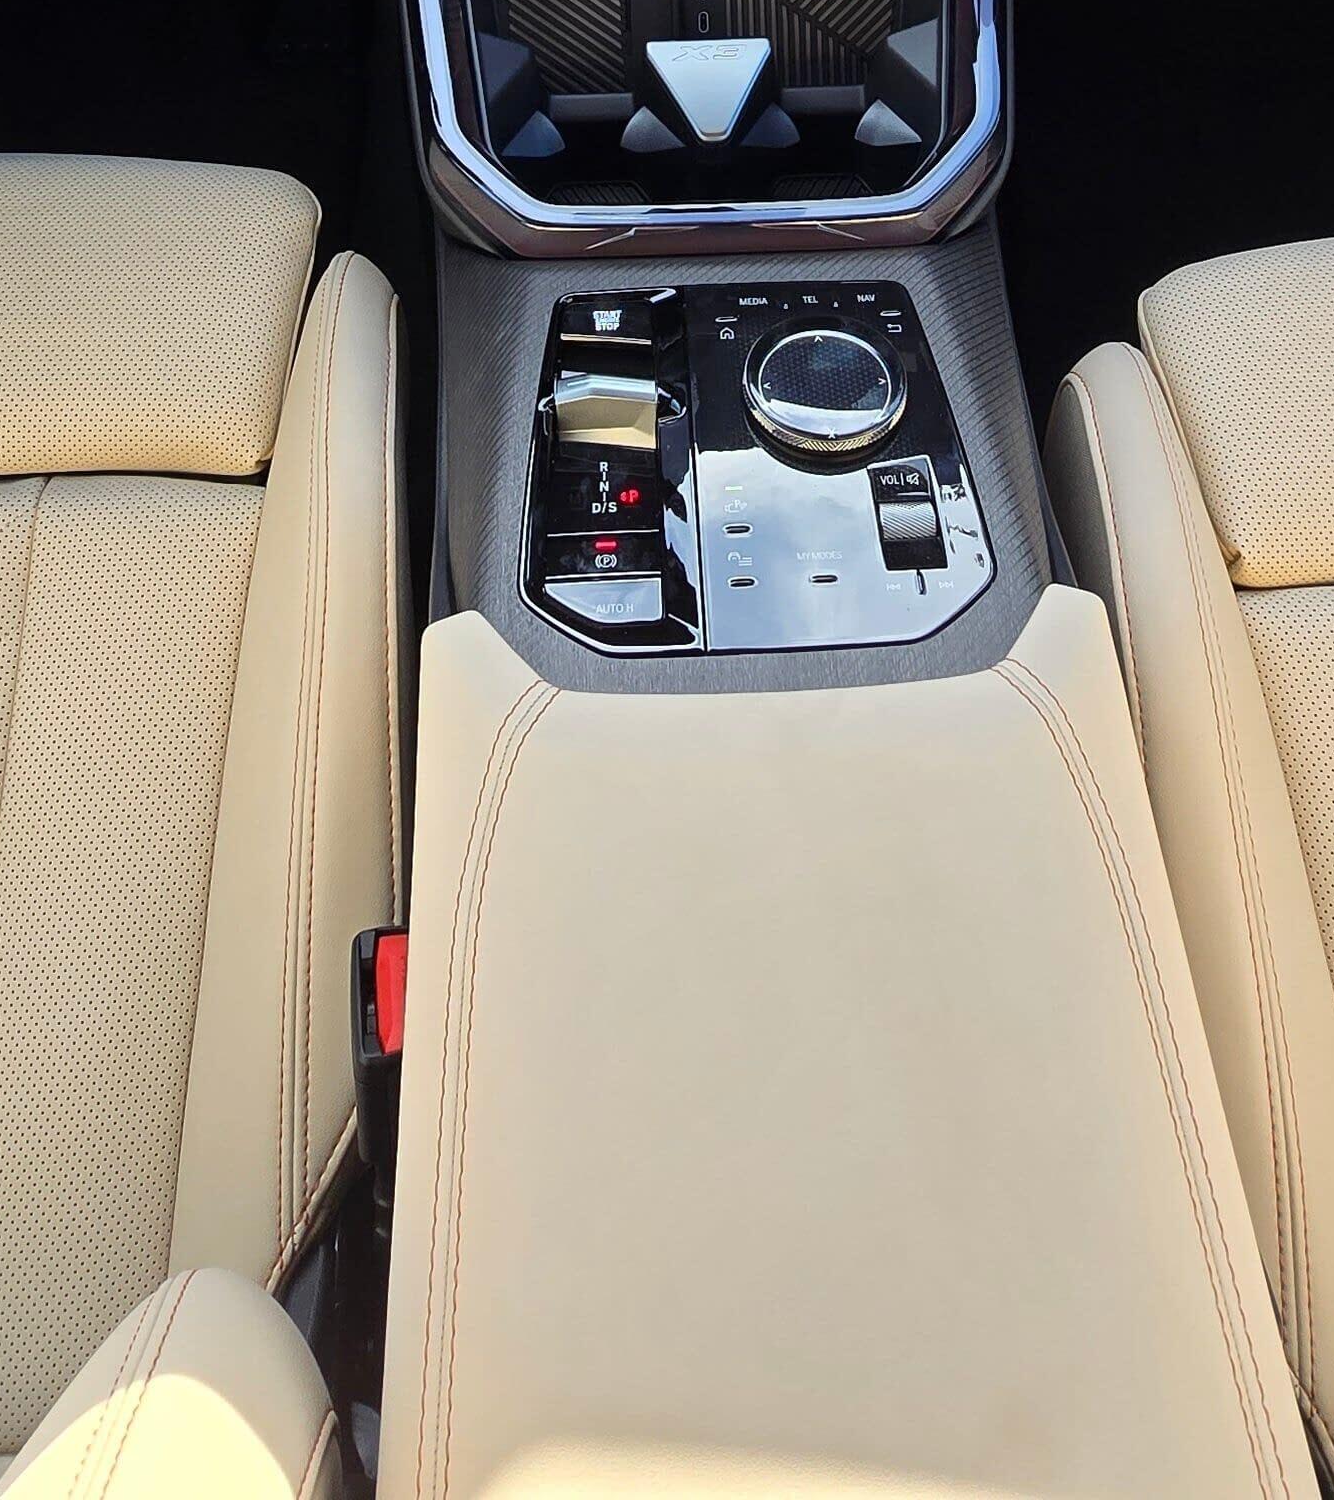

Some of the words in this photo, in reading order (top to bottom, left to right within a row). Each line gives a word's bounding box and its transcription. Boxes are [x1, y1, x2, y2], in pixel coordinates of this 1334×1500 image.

[672, 44, 747, 61] X3
[739, 297, 768, 306] MEDIA
[803, 295, 818, 304] TEL
[857, 294, 876, 302] NAV
[595, 322, 620, 331] STOP
[599, 462, 608, 472] R
[880, 474, 899, 485] VOL
[599, 481, 609, 492] N
[592, 502, 617, 513] D/S
[596, 603, 624, 614] AUTO
[627, 603, 634, 613] H
